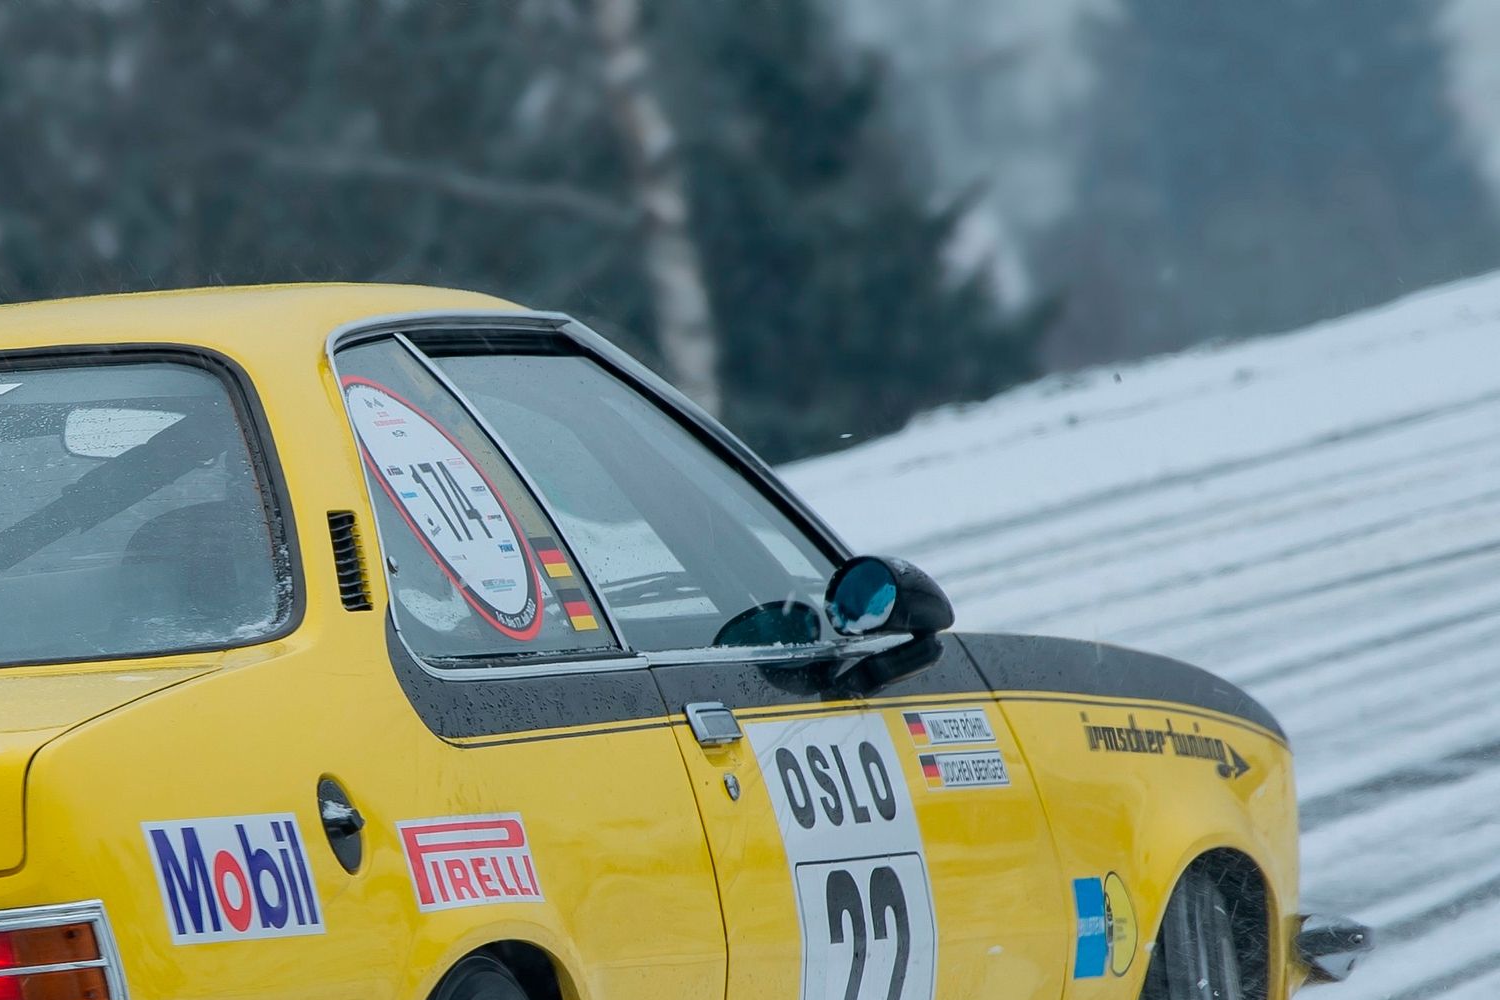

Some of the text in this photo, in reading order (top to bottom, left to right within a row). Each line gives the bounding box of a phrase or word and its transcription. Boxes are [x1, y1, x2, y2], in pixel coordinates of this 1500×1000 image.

[408, 461, 493, 542] 174
[928, 718, 964, 740] WALTER
[1080, 711, 1166, 755] irmscher
[775, 740, 896, 829] OSLO
[971, 758, 1007, 782] BERGER
[149, 820, 319, 936] Mobil
[400, 819, 540, 906] PIRELLI
